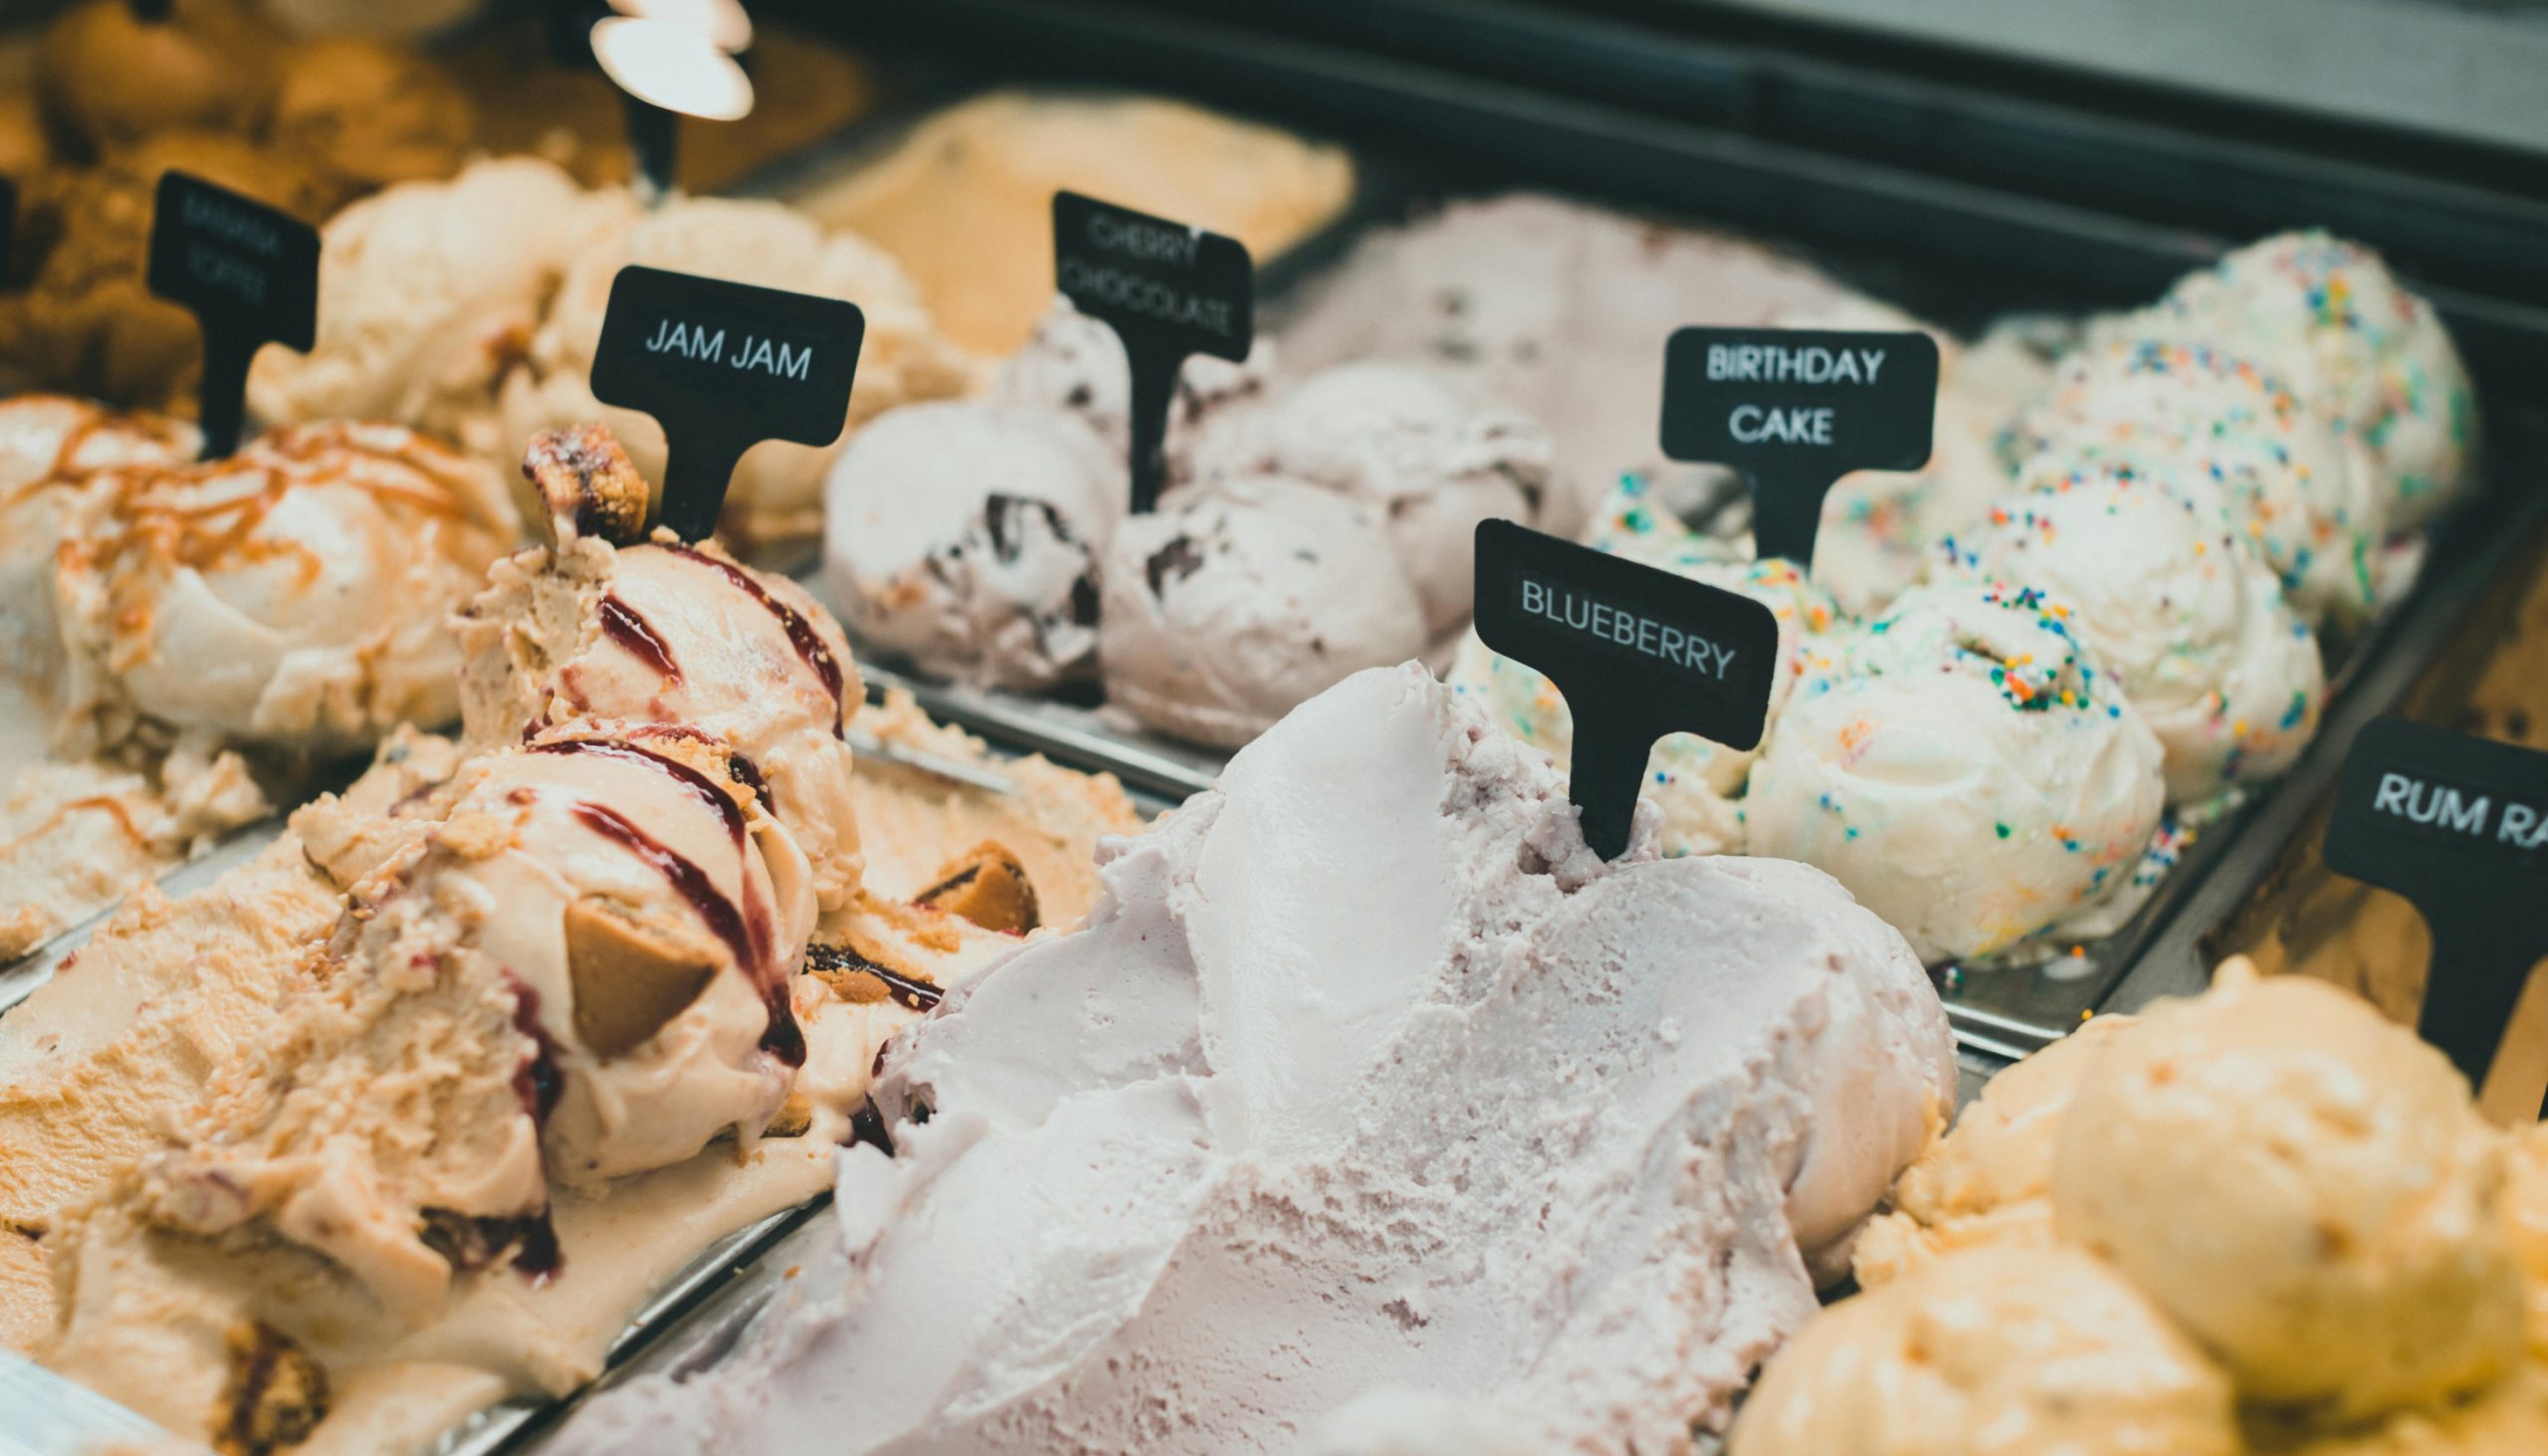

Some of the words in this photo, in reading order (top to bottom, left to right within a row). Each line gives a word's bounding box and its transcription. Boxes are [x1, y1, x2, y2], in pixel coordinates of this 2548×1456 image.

[1087, 212, 1194, 265] CHERRY
[1061, 258, 1232, 336] CHOCOLATE
[646, 318, 726, 363] JAM
[732, 335, 812, 380] JAM
[1706, 344, 1886, 384] BIRTHDAY
[1729, 404, 1835, 445] CAKE
[1523, 579, 1737, 680] BLUEBERRY
[2373, 772, 2491, 836] RUM
